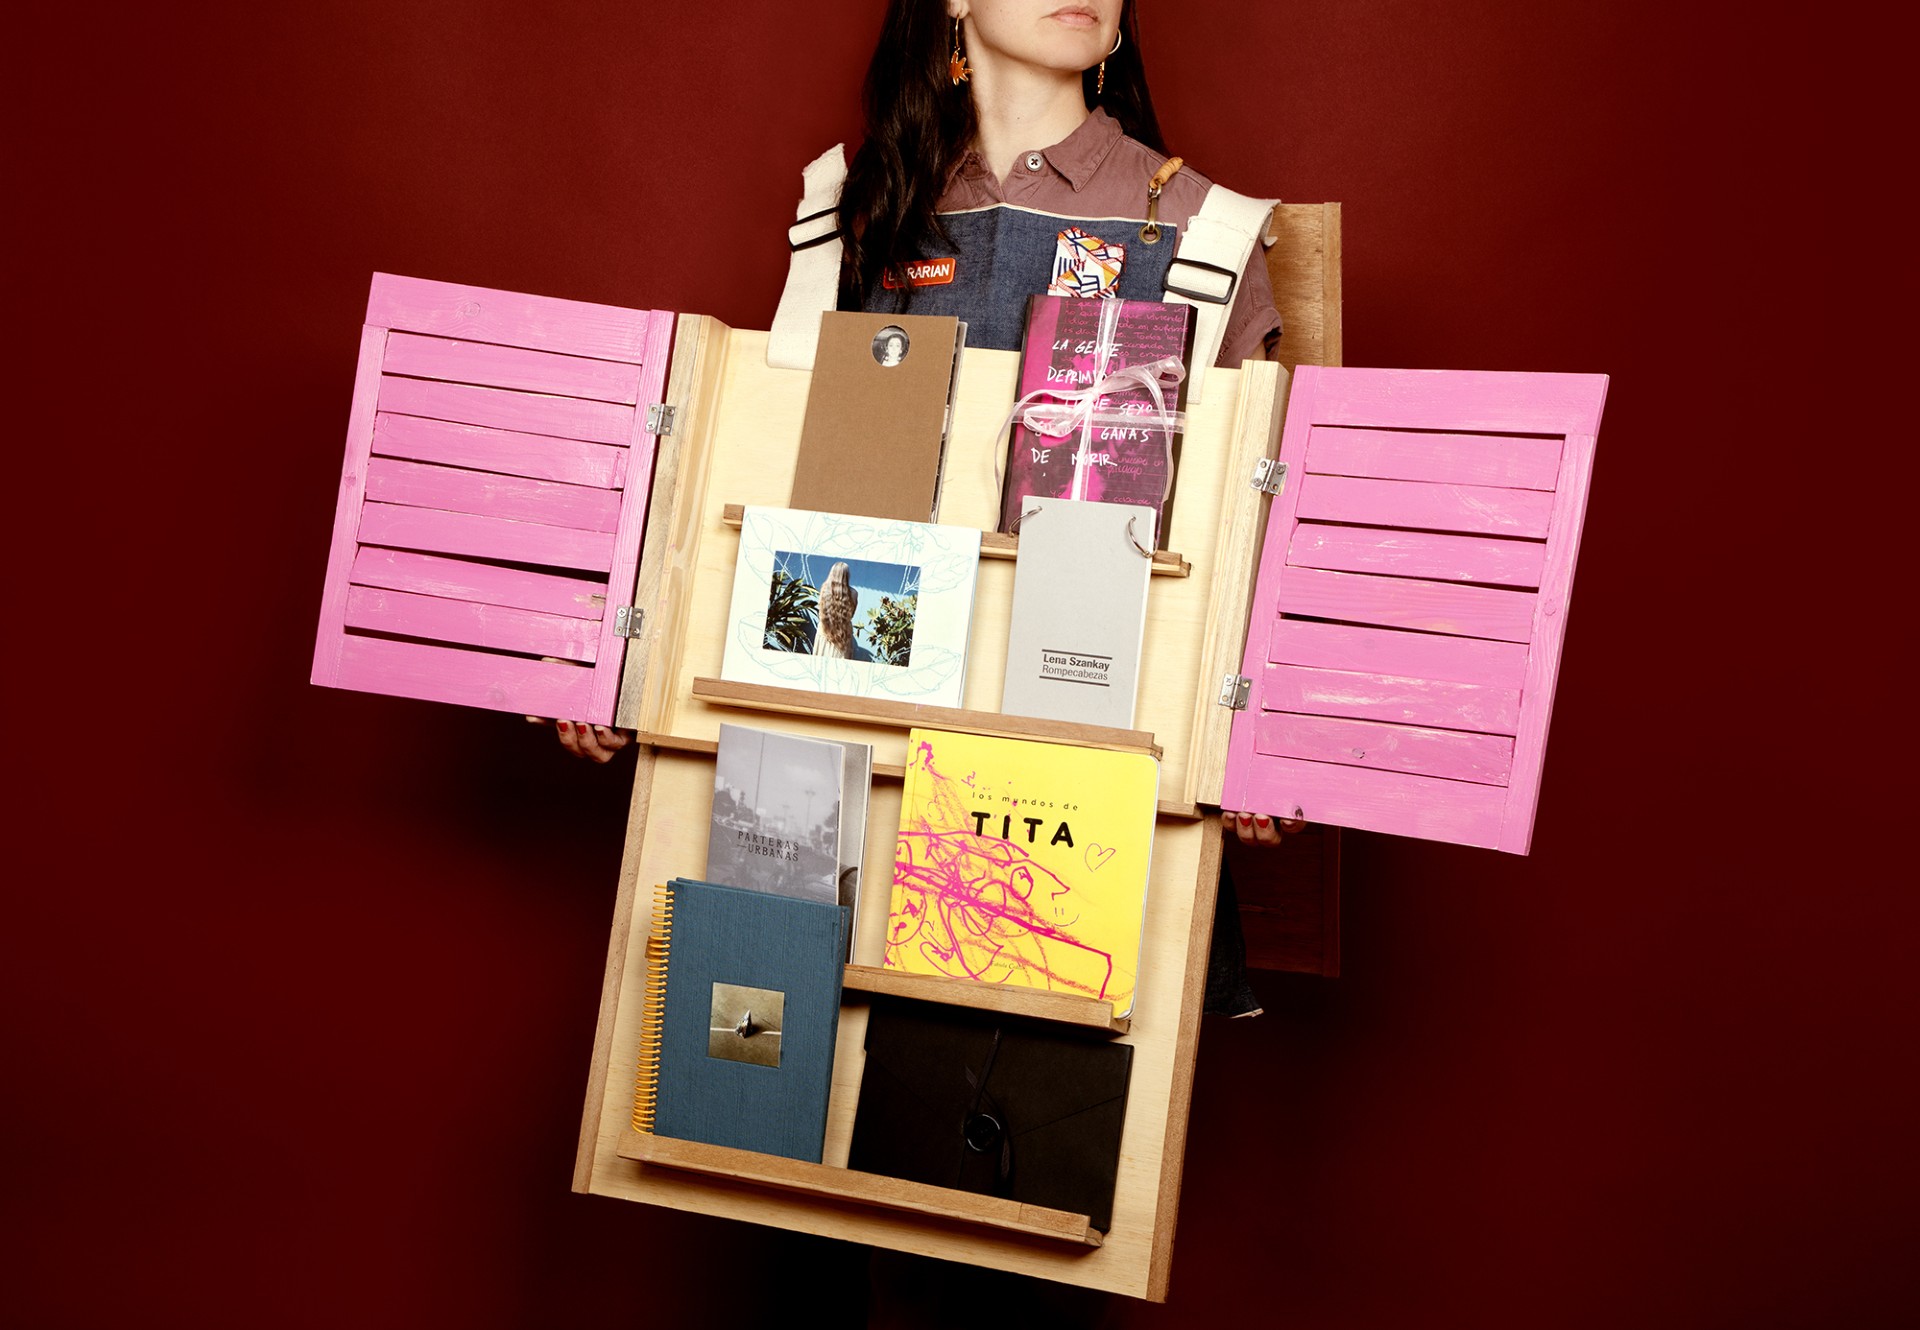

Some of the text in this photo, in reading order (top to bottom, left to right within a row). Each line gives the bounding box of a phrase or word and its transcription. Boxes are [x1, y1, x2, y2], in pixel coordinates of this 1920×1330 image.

[888, 264, 950, 282] LRARIAN
[1052, 339, 1069, 351] LA
[1047, 366, 1117, 384] DEPRIM
[1119, 402, 1153, 416] SEXO
[1100, 427, 1151, 443] GANAS
[1031, 447, 1051, 464] DE
[1043, 653, 1111, 672] Lena Szankay
[1041, 664, 1109, 681] Rompecabezas
[972, 792, 1079, 812] los mundos de
[970, 811, 1075, 849] TITA
[737, 830, 800, 852] PARTERAS
